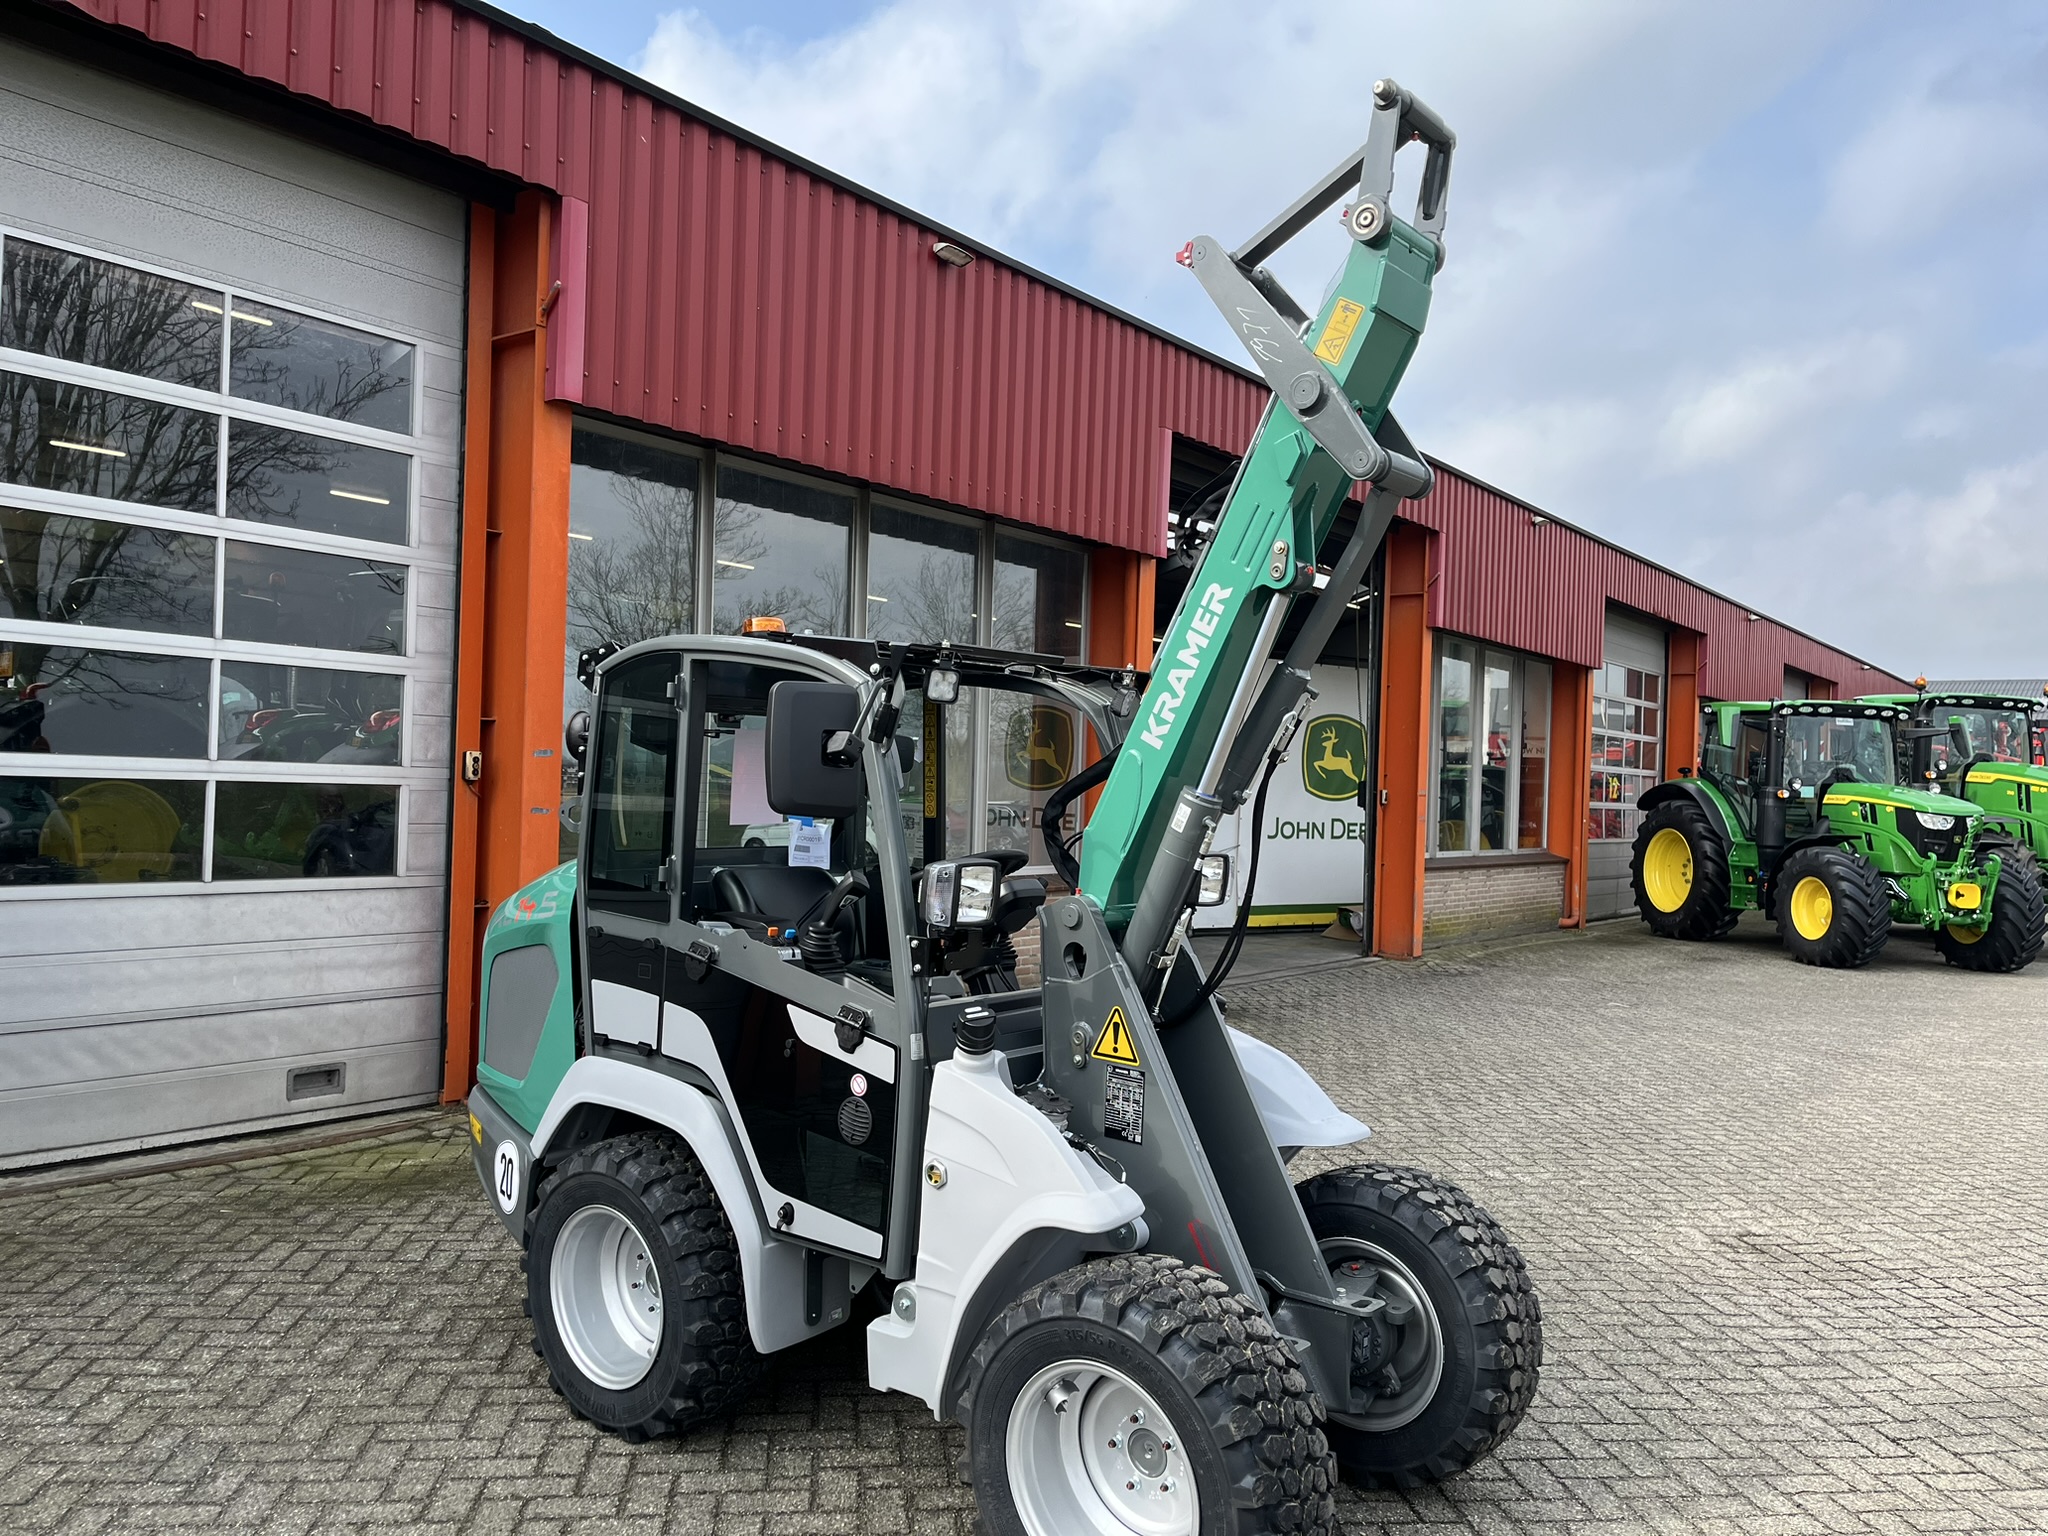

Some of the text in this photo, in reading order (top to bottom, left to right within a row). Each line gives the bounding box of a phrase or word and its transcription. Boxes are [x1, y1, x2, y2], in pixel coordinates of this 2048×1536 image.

[1140, 582, 1234, 750] KRAMER
[987, 808, 1026, 828] OHN
[1267, 817, 1325, 839] JOHN
[500, 1152, 514, 1201] 20
